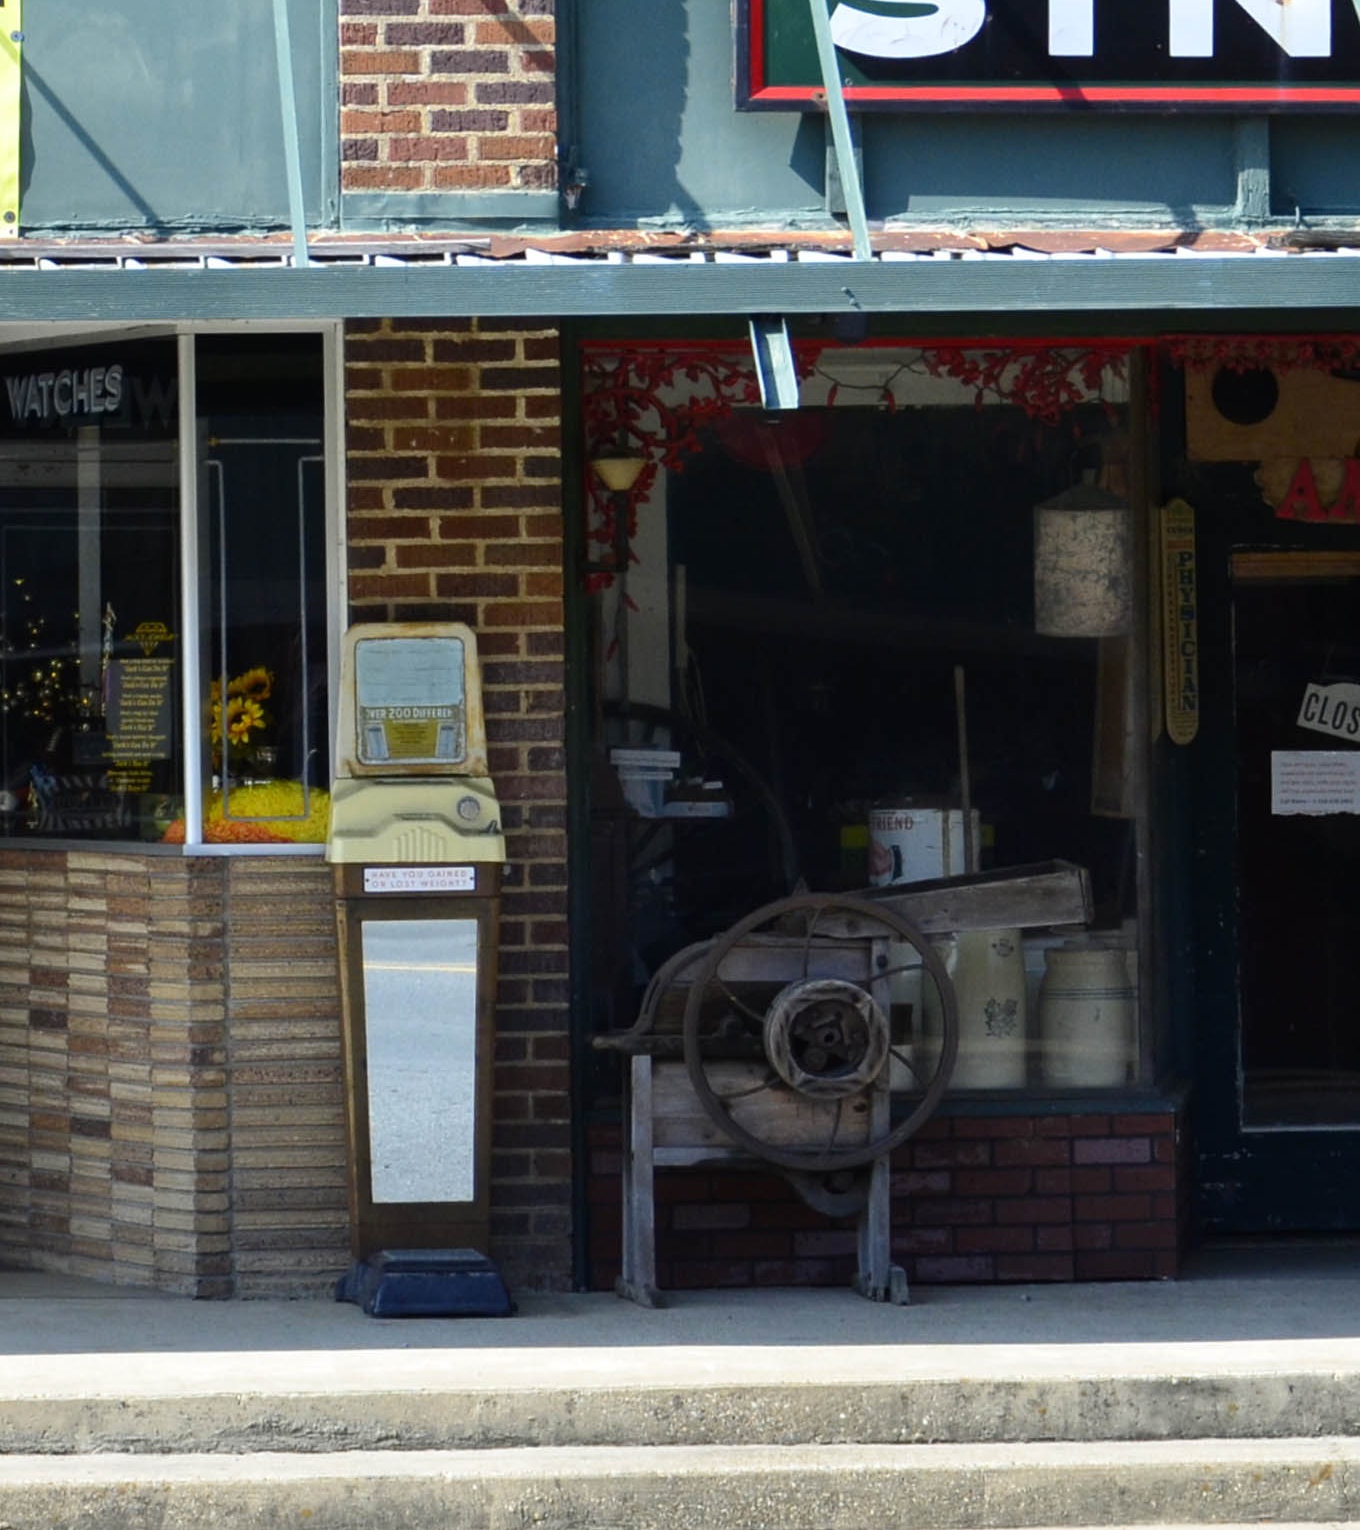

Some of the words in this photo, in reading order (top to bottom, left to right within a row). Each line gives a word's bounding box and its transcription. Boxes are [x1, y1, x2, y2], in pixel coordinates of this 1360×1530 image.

[4, 364, 123, 420] WATCHES
[388, 708, 411, 719] 200
[371, 870, 397, 878] HAVE
[402, 870, 423, 878] YOU
[427, 870, 468, 878] GAINED
[371, 880, 386, 888] OR
[390, 880, 415, 888] LOST
